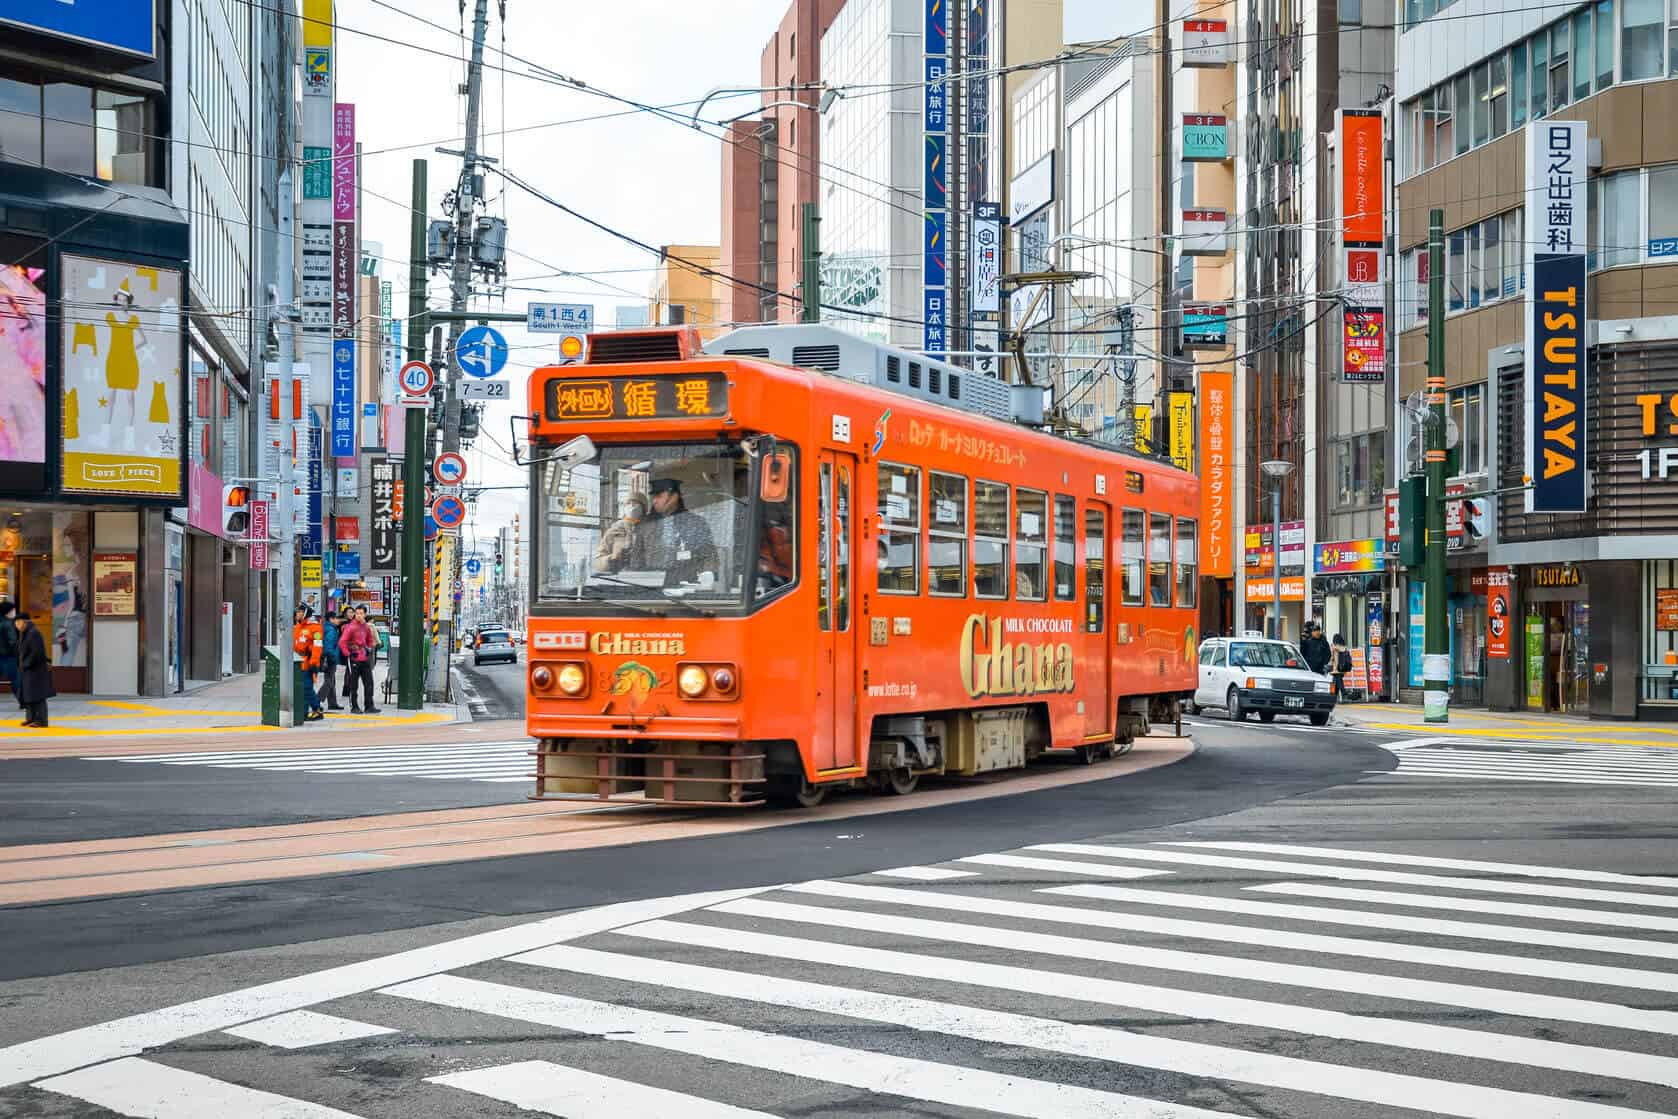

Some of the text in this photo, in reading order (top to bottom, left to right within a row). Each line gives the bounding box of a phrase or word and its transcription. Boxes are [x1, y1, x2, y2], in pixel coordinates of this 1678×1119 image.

[928, 66, 943, 124] 日本旅行
[1547, 127, 1573, 252] 日之出歯科
[978, 207, 996, 218] 3F
[928, 297, 942, 352] 日本旅行
[406, 371, 427, 388] 40
[1543, 286, 1577, 480] TSUTAYA
[335, 366, 351, 448] 七十七銀行
[91, 469, 116, 478] LOVE
[1638, 448, 1678, 480] 1F
[1538, 567, 1580, 586] TSUTAYA
[1005, 617, 1073, 633] MILK CHOCOLATE
[590, 631, 687, 656] Ghana
[960, 610, 1075, 700] Ghana
